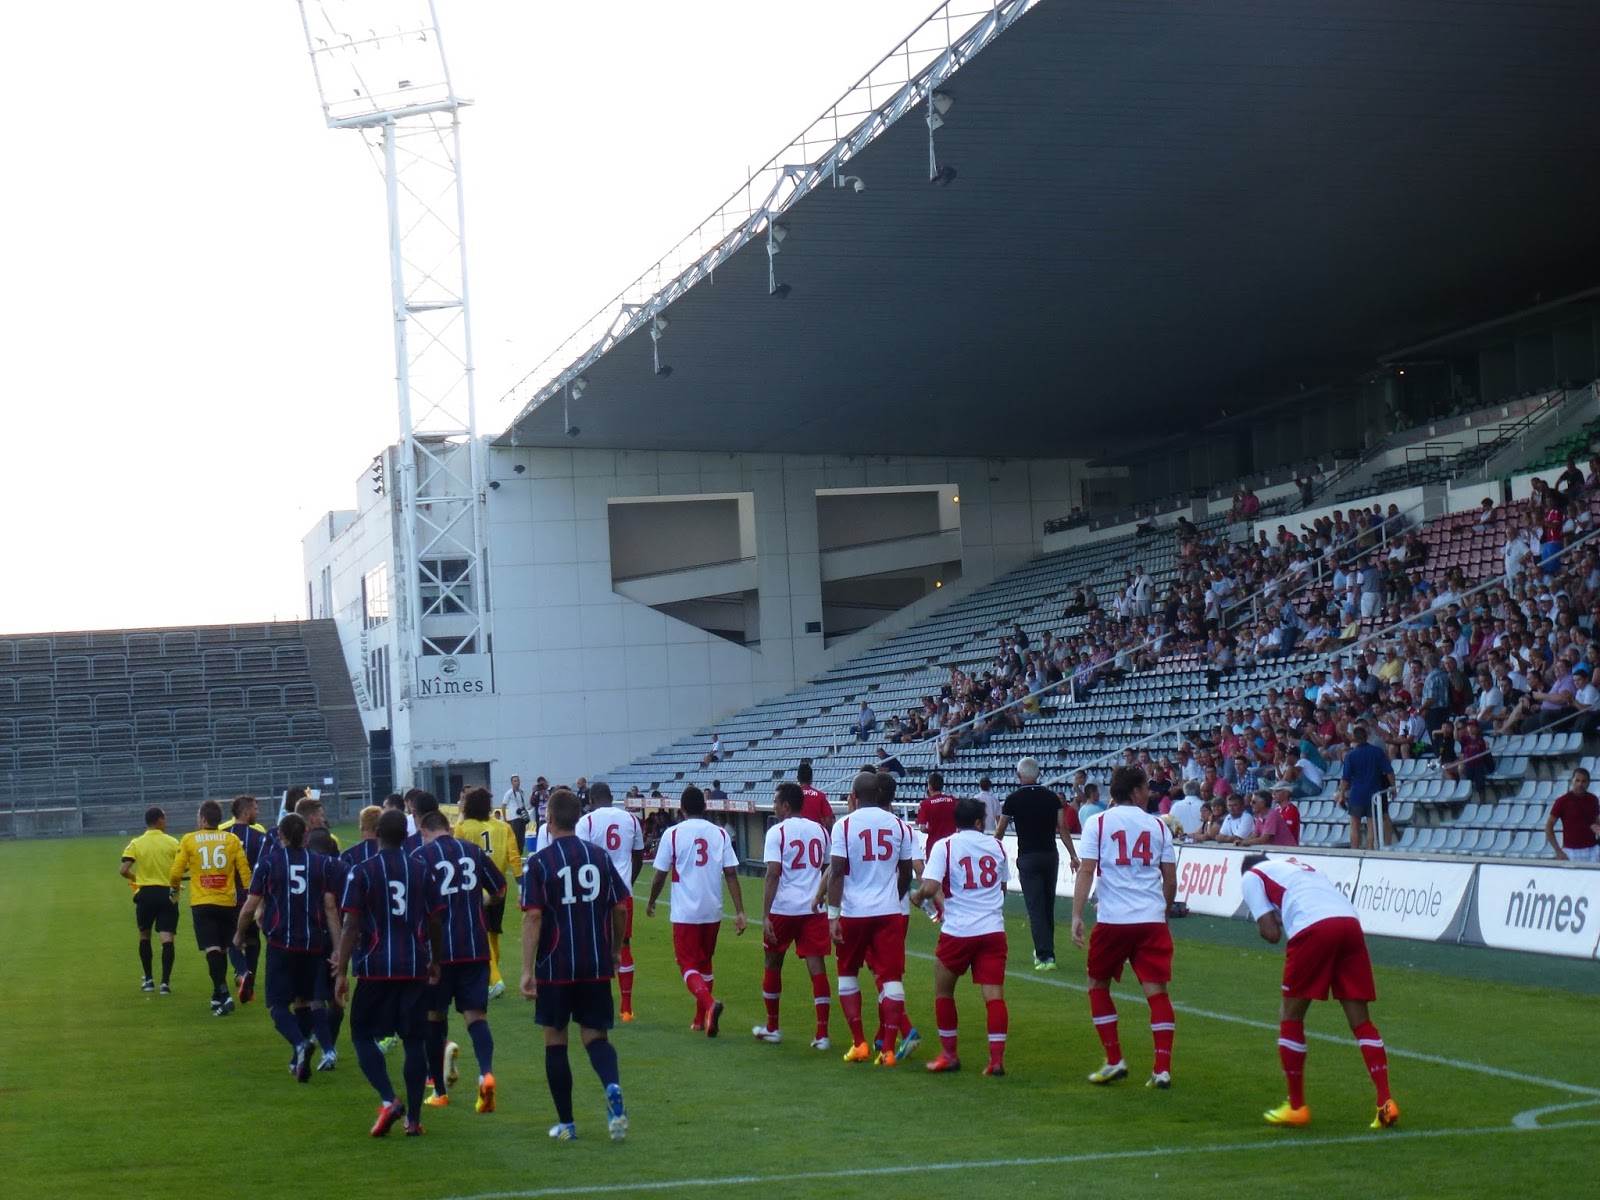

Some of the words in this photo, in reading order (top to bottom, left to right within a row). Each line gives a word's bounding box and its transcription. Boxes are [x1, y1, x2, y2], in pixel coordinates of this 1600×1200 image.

[421, 676, 484, 695] Nîmes
[480, 830, 493, 854] 1
[605, 823, 622, 851] 6
[694, 838, 709, 866] 3
[789, 838, 823, 869] 20
[858, 828, 893, 862] 15
[1110, 829, 1153, 867] 14
[197, 845, 227, 870] 16
[958, 855, 998, 889] 18
[289, 864, 307, 895] 5
[434, 856, 478, 896] 23
[556, 863, 601, 905] 19
[1177, 856, 1229, 903] sport
[388, 880, 407, 916] 3
[1356, 877, 1442, 922] métropole
[1505, 879, 1589, 934] nîmes
